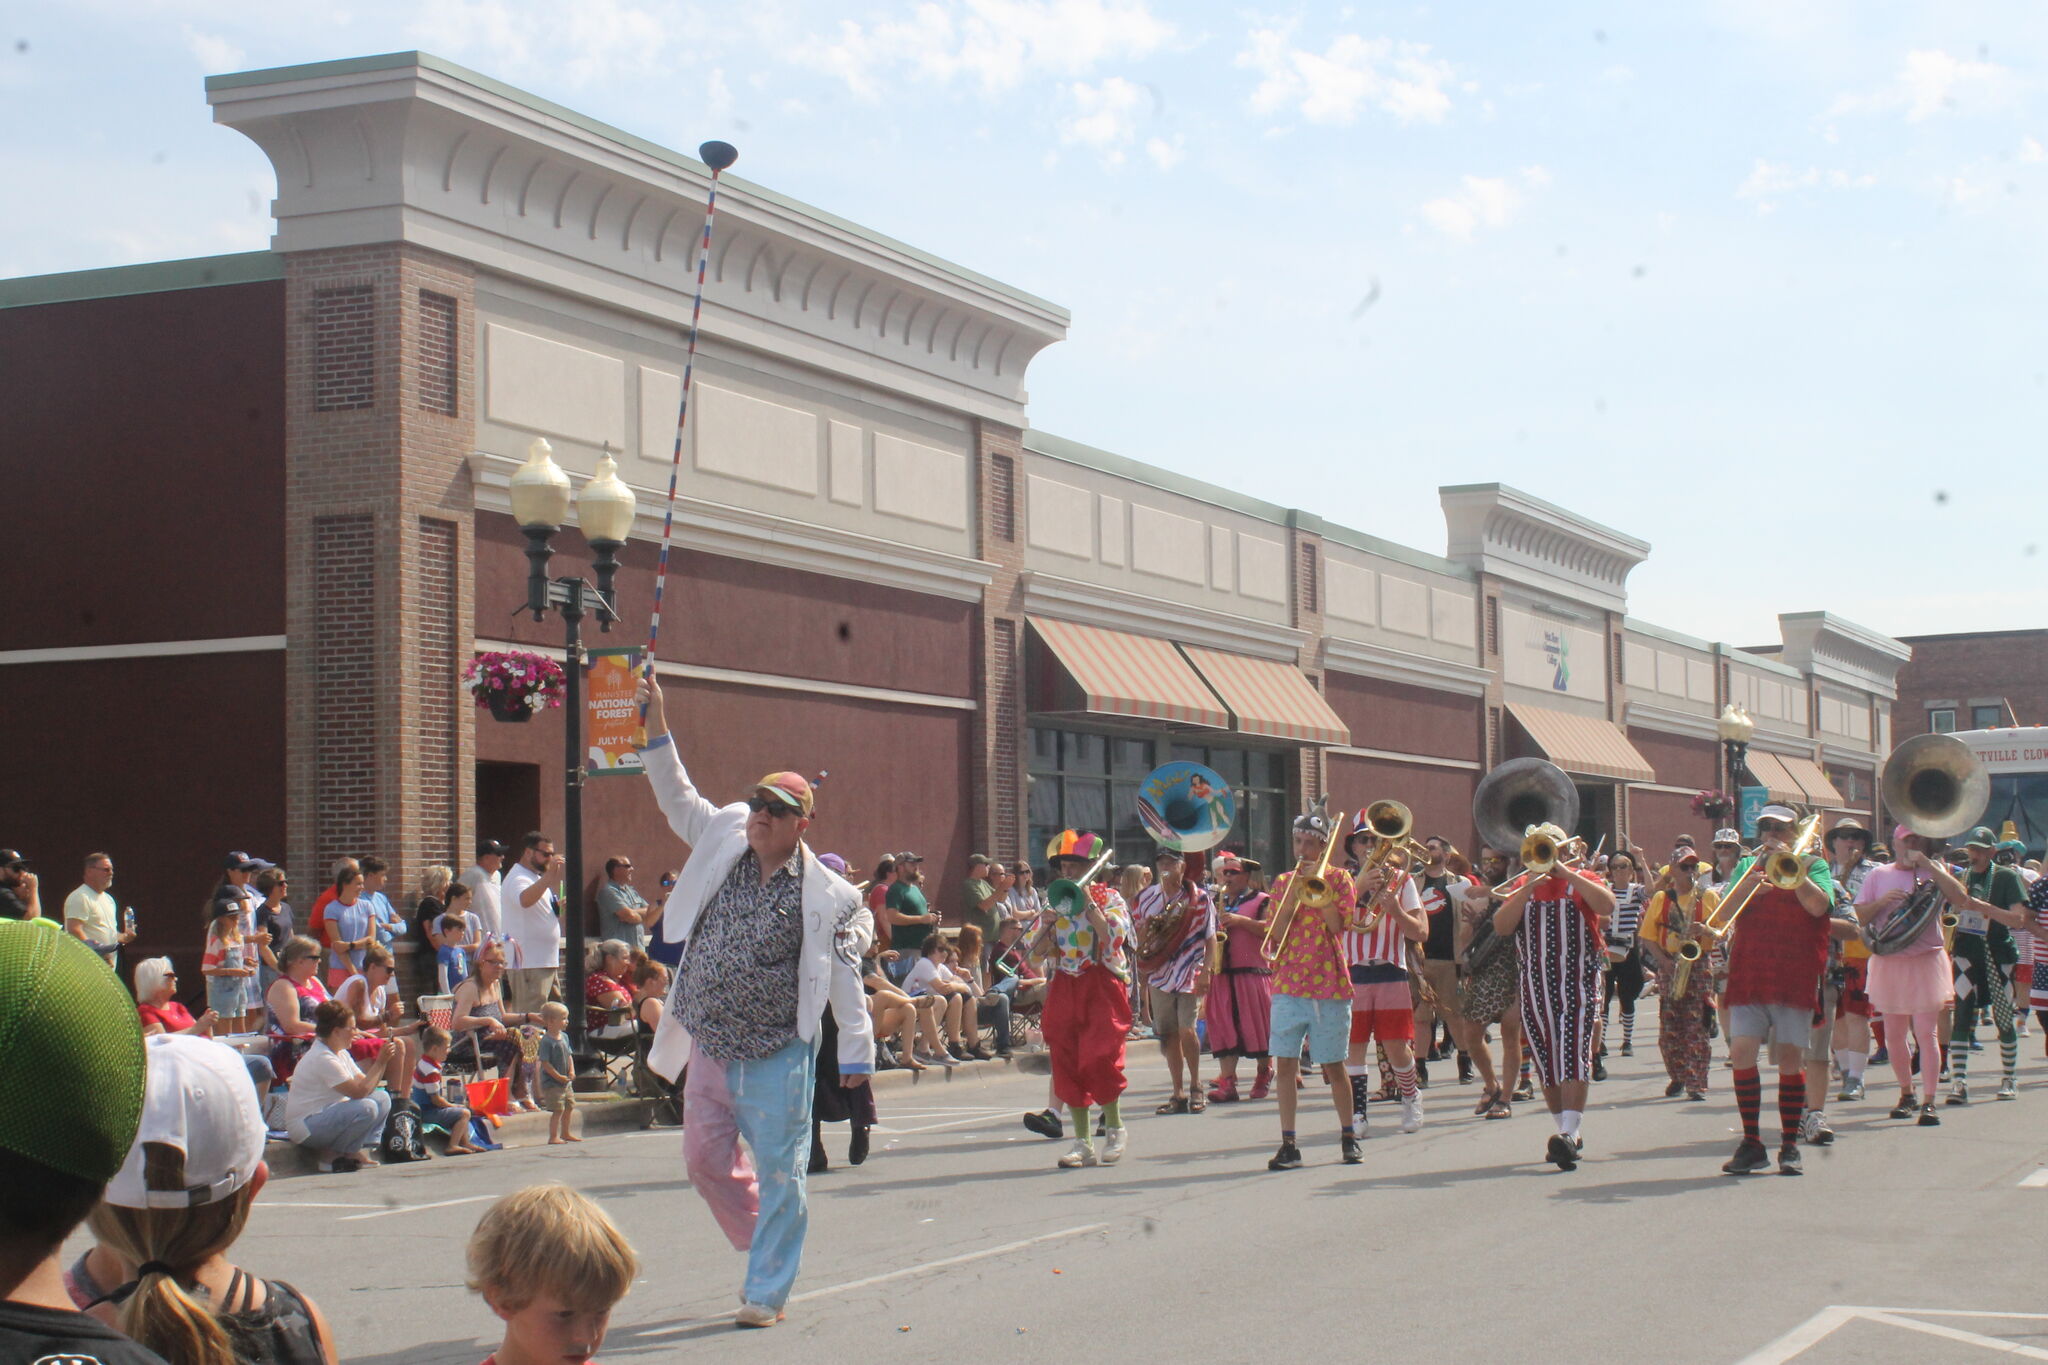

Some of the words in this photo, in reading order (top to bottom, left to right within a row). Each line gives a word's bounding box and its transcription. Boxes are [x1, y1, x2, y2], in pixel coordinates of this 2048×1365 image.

[596, 708, 633, 719] FOREST
[597, 736, 617, 746] JULY
[619, 735, 632, 745] 1-4
